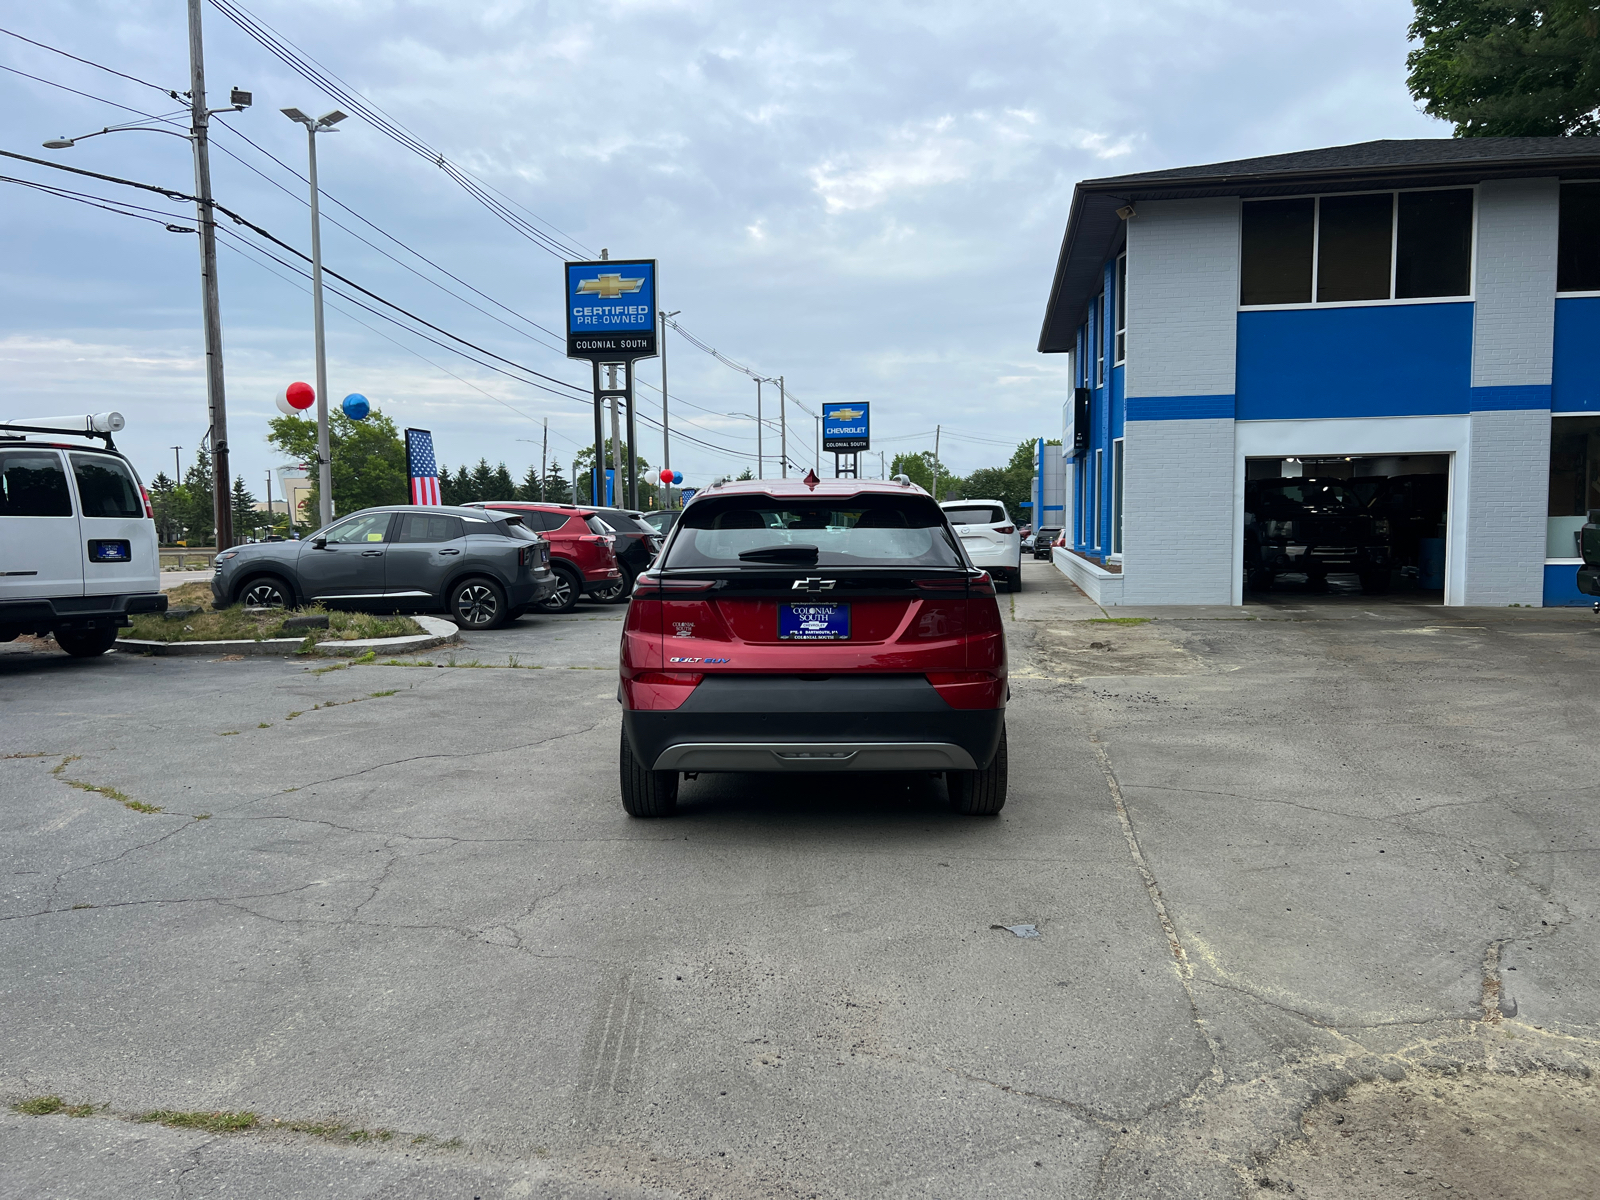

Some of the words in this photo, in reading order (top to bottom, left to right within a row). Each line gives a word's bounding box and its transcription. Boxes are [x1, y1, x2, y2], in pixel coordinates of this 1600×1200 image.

[573, 305, 649, 316] CERTIFIED
[577, 315, 645, 325] PRE-OWNED
[576, 340, 616, 349] COLONIAL
[620, 339, 647, 348] SOUTH
[792, 607, 836, 615] COLONIAL
